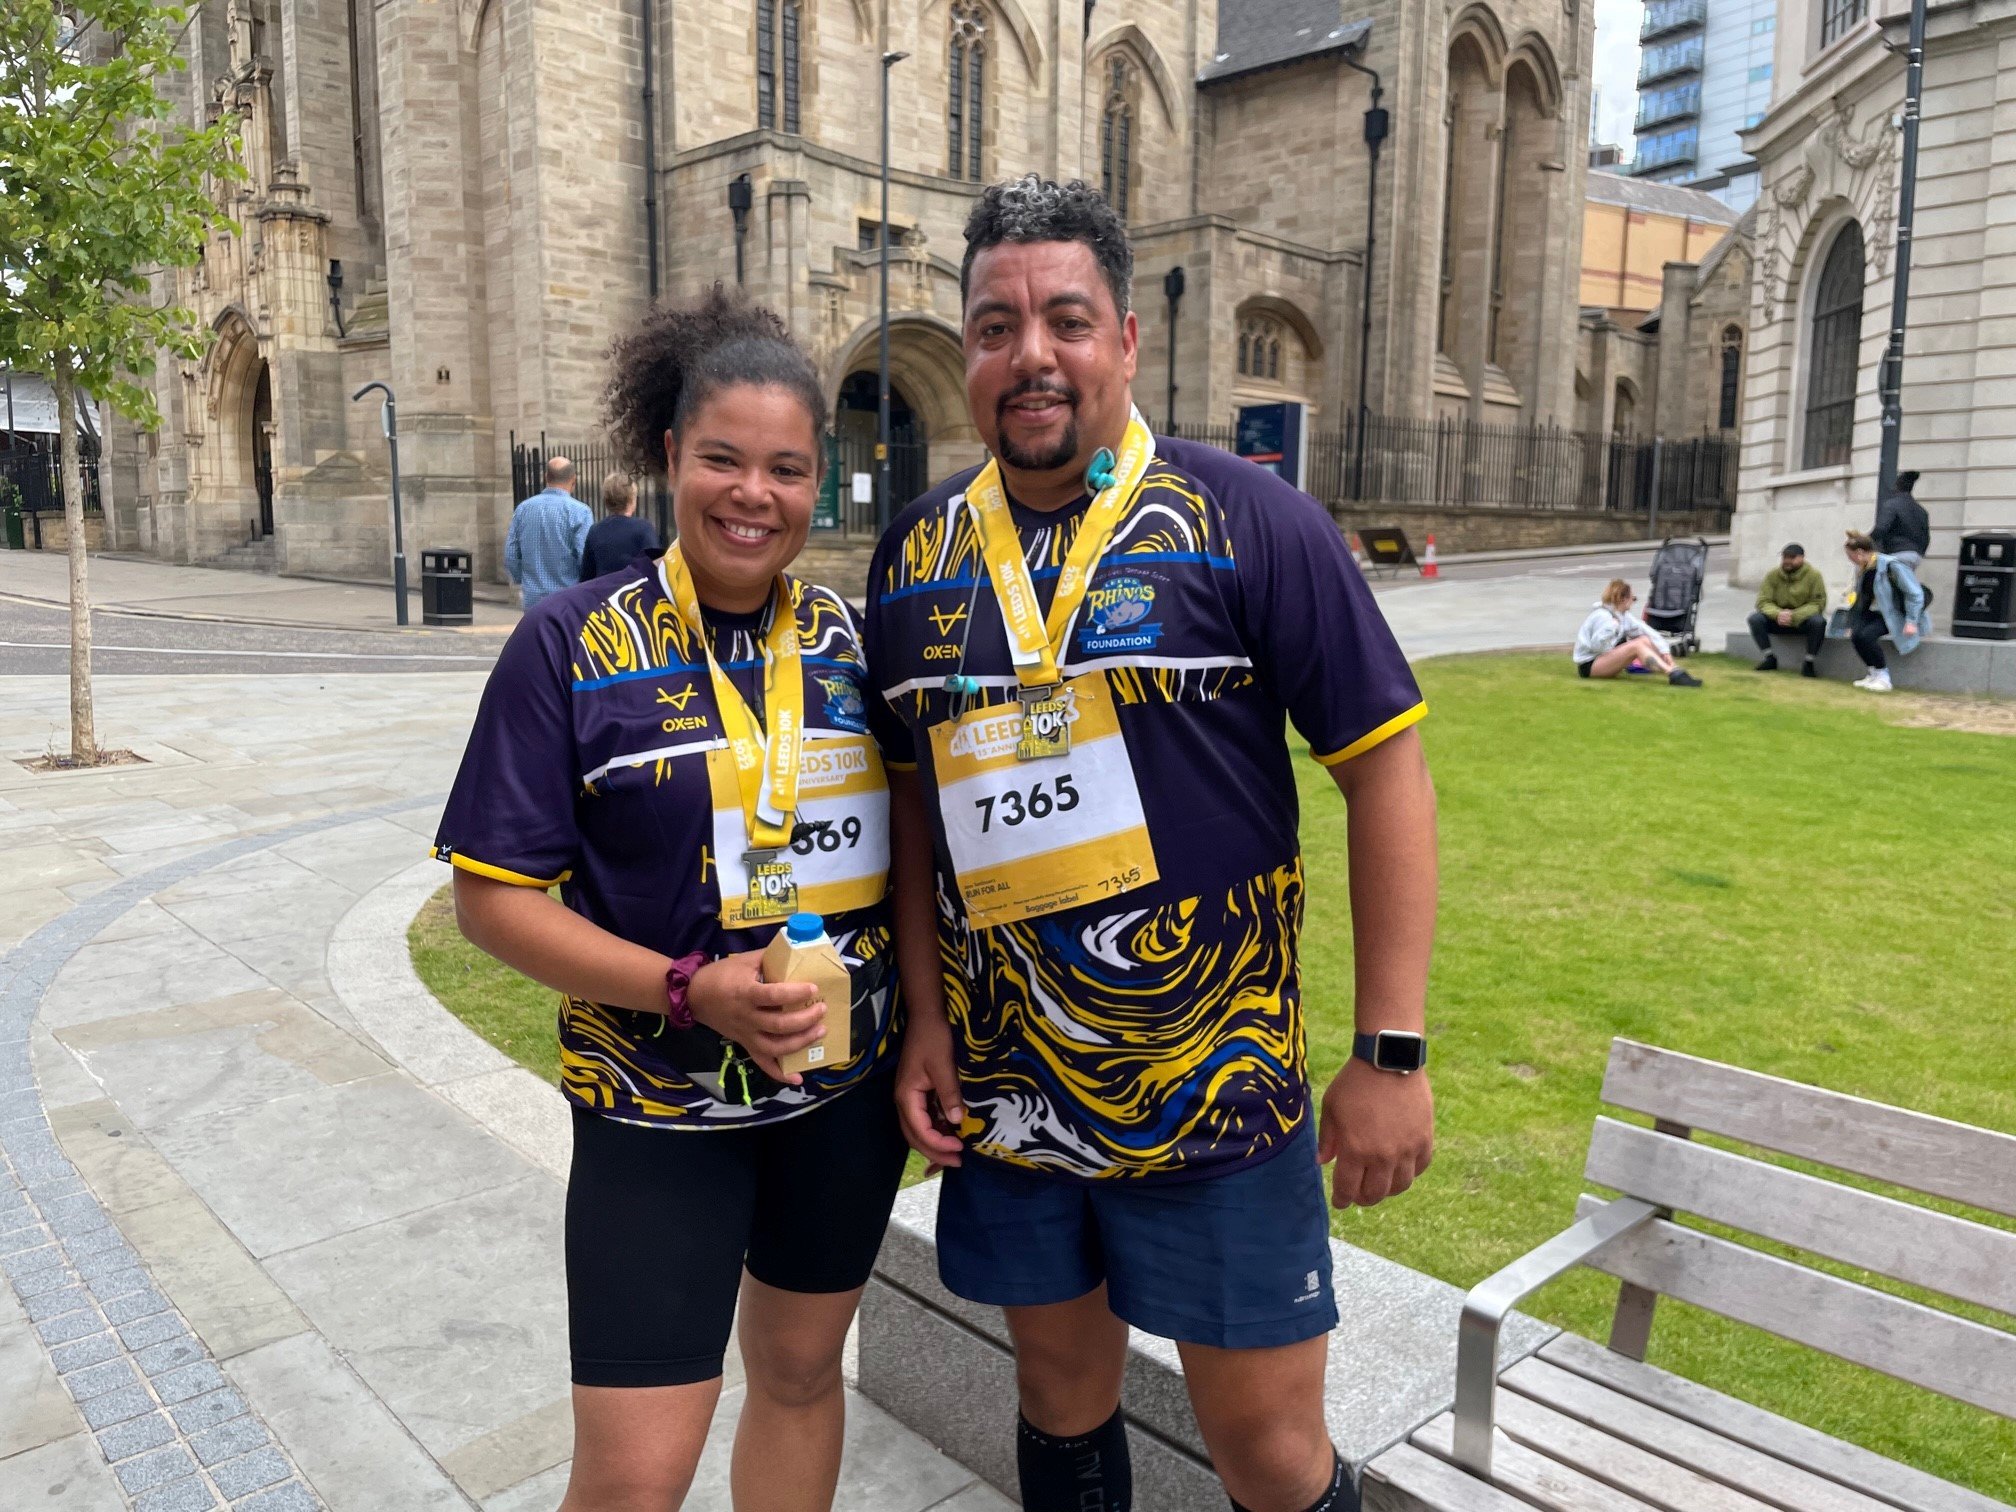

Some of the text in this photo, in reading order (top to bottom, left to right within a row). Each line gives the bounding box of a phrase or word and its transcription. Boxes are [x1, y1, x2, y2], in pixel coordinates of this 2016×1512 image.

[1006, 584, 1028, 624] LEEDS
[923, 644, 964, 660] OXEN
[1087, 635, 1152, 649] FOUNDATION
[1031, 700, 1063, 714] LEEDS
[662, 715, 708, 733] OXEN
[973, 718, 1023, 746] LEED
[1031, 711, 1064, 736] 10K
[776, 709, 793, 775] LEEDS 10K
[800, 750, 865, 774] EDS 10K
[975, 774, 1080, 834] 7365
[757, 862, 793, 876] LEEDS
[1098, 867, 1142, 892] 7365
[757, 873, 794, 896] 10K
[965, 886, 981, 899] RUN
[981, 884, 997, 896] FOR
[997, 881, 1011, 892] ALL
[1025, 900, 1058, 913] Baggage
[1059, 893, 1079, 905] label
[730, 912, 742, 921] RU
